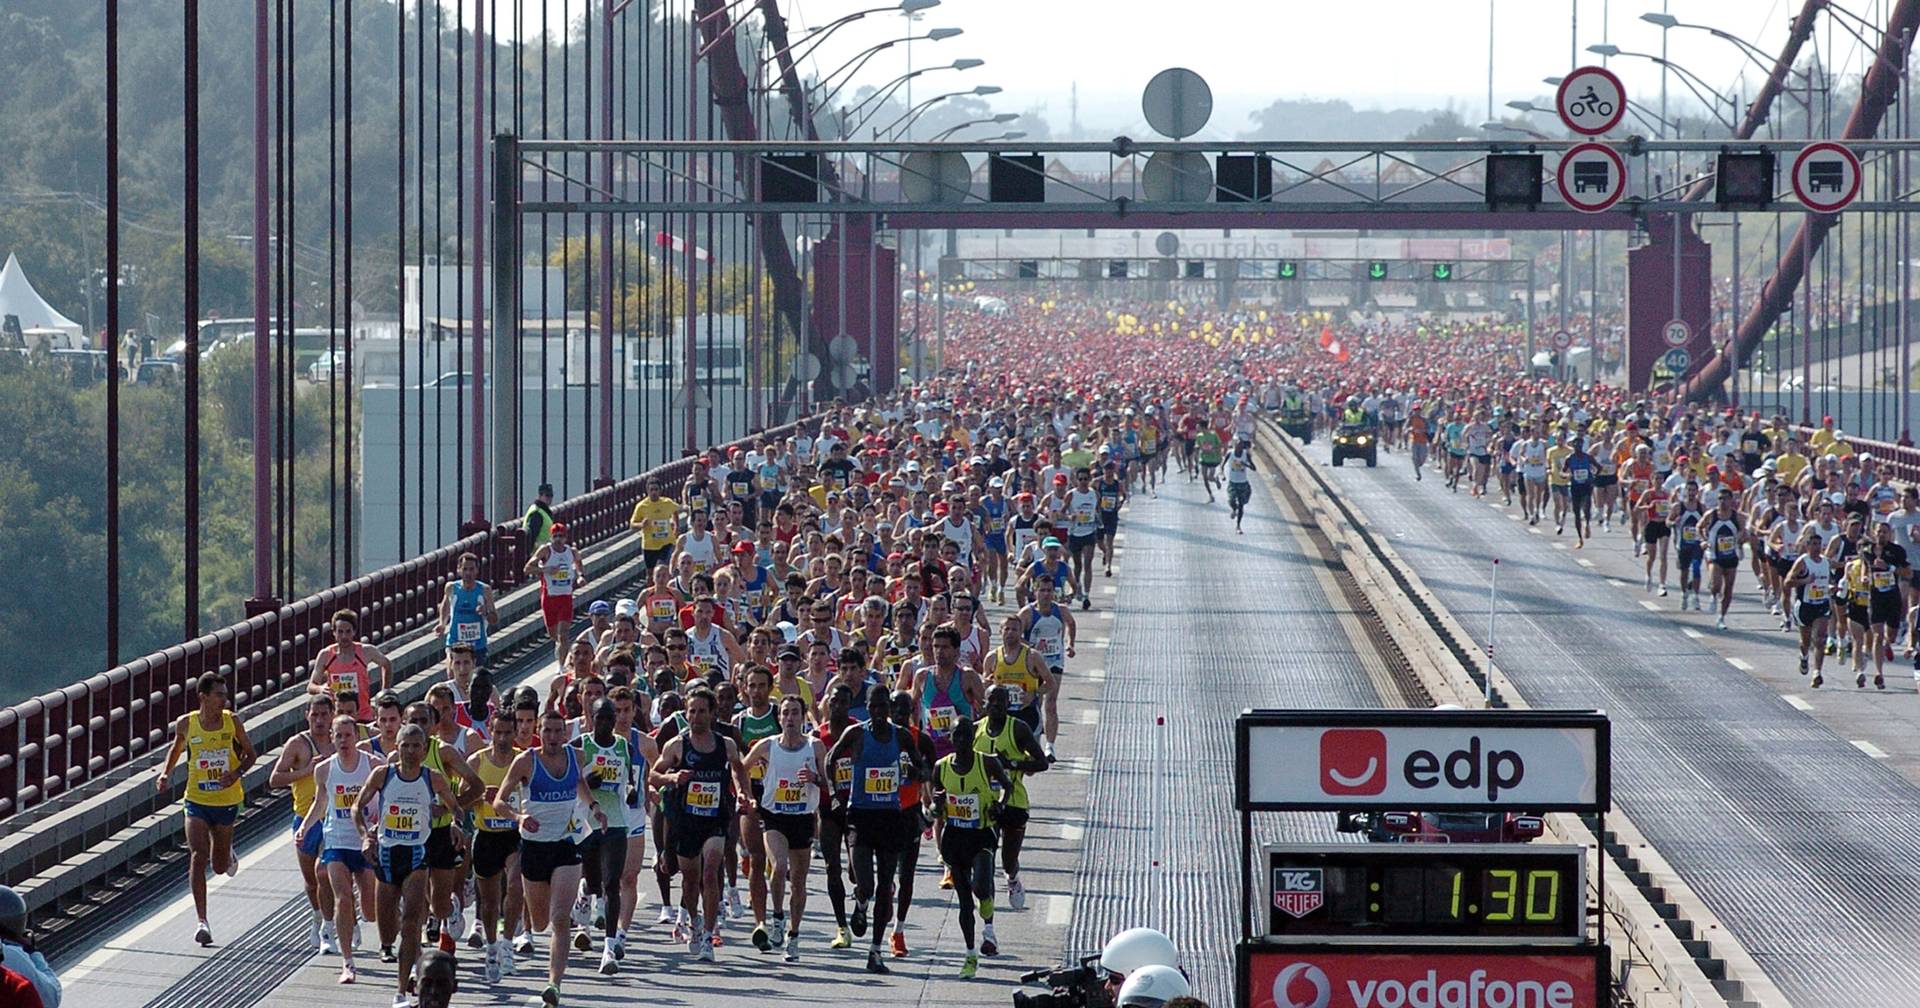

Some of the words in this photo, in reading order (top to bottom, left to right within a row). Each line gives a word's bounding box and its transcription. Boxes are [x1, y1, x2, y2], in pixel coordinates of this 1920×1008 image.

[1669, 328, 1686, 339] 70
[1666, 353, 1688, 367] 40
[210, 759, 225, 767] edp
[607, 759, 622, 767] edp
[880, 769, 896, 778] edp
[1403, 736, 1525, 802] edp
[703, 784, 718, 793] edp
[958, 796, 975, 805] edp
[400, 807, 418, 816] edp
[396, 816, 413, 829] 104
[1281, 871, 1316, 890] TAG
[1276, 893, 1320, 915] HEUER
[1346, 969, 1574, 1008] vodafone
